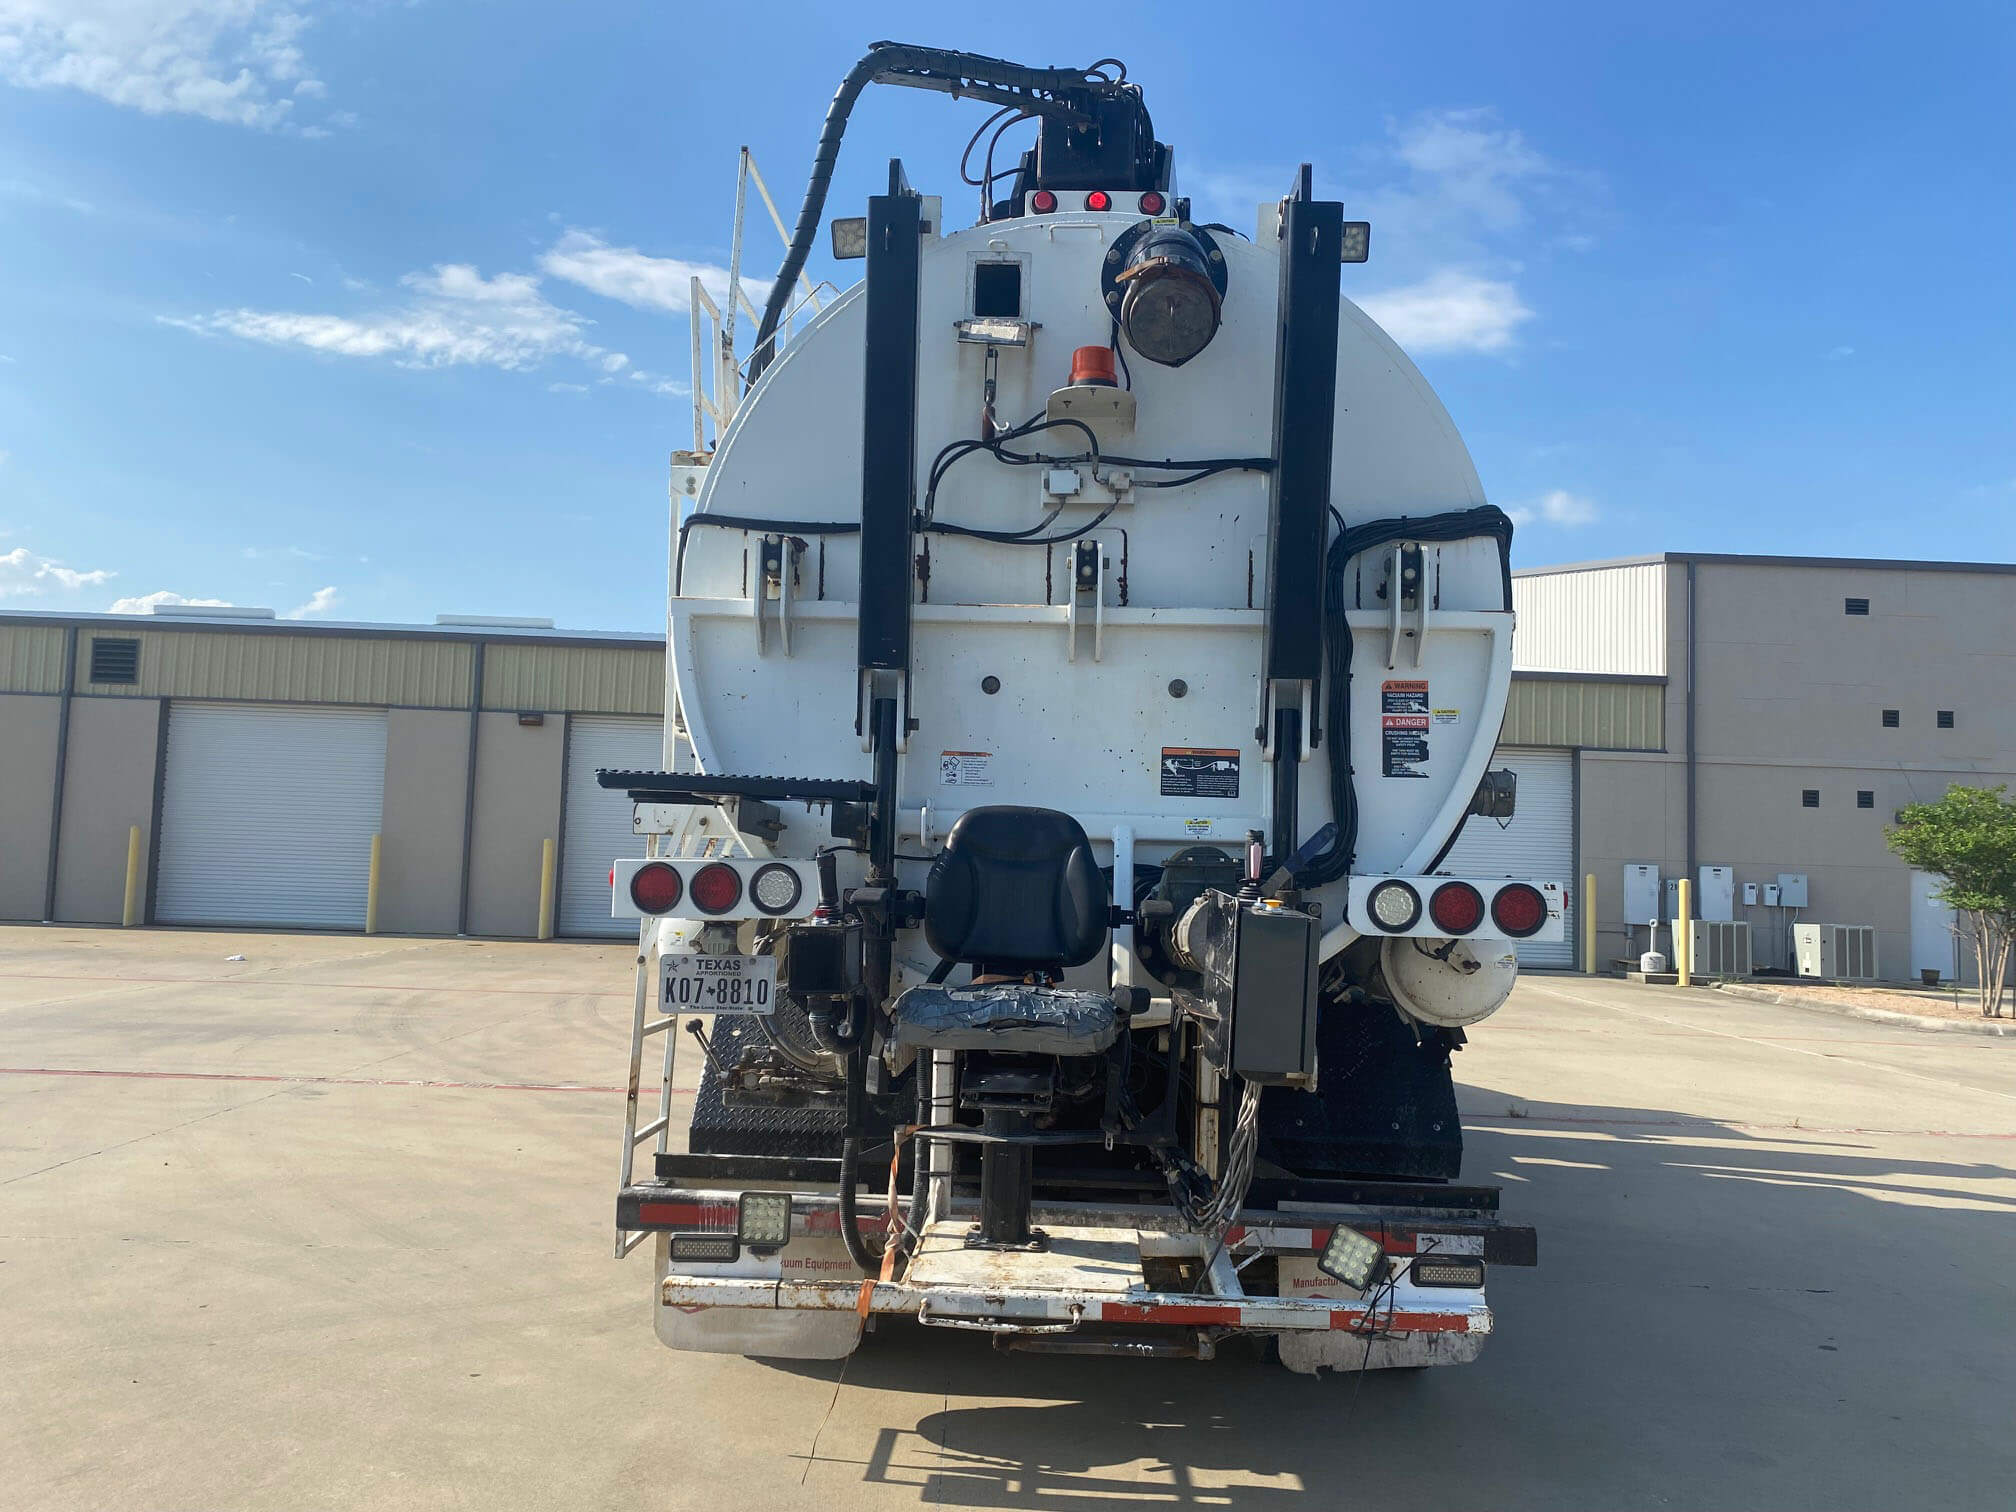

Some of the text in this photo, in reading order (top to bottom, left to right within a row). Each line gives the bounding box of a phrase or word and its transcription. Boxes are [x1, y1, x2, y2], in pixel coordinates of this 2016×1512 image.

[1394, 682, 1426, 690] WARNING
[1395, 718, 1426, 726] DANGER
[696, 959, 741, 971] TEXAS
[665, 977, 769, 1005] K07 8810
[781, 1257, 852, 1272] uum Equipment
